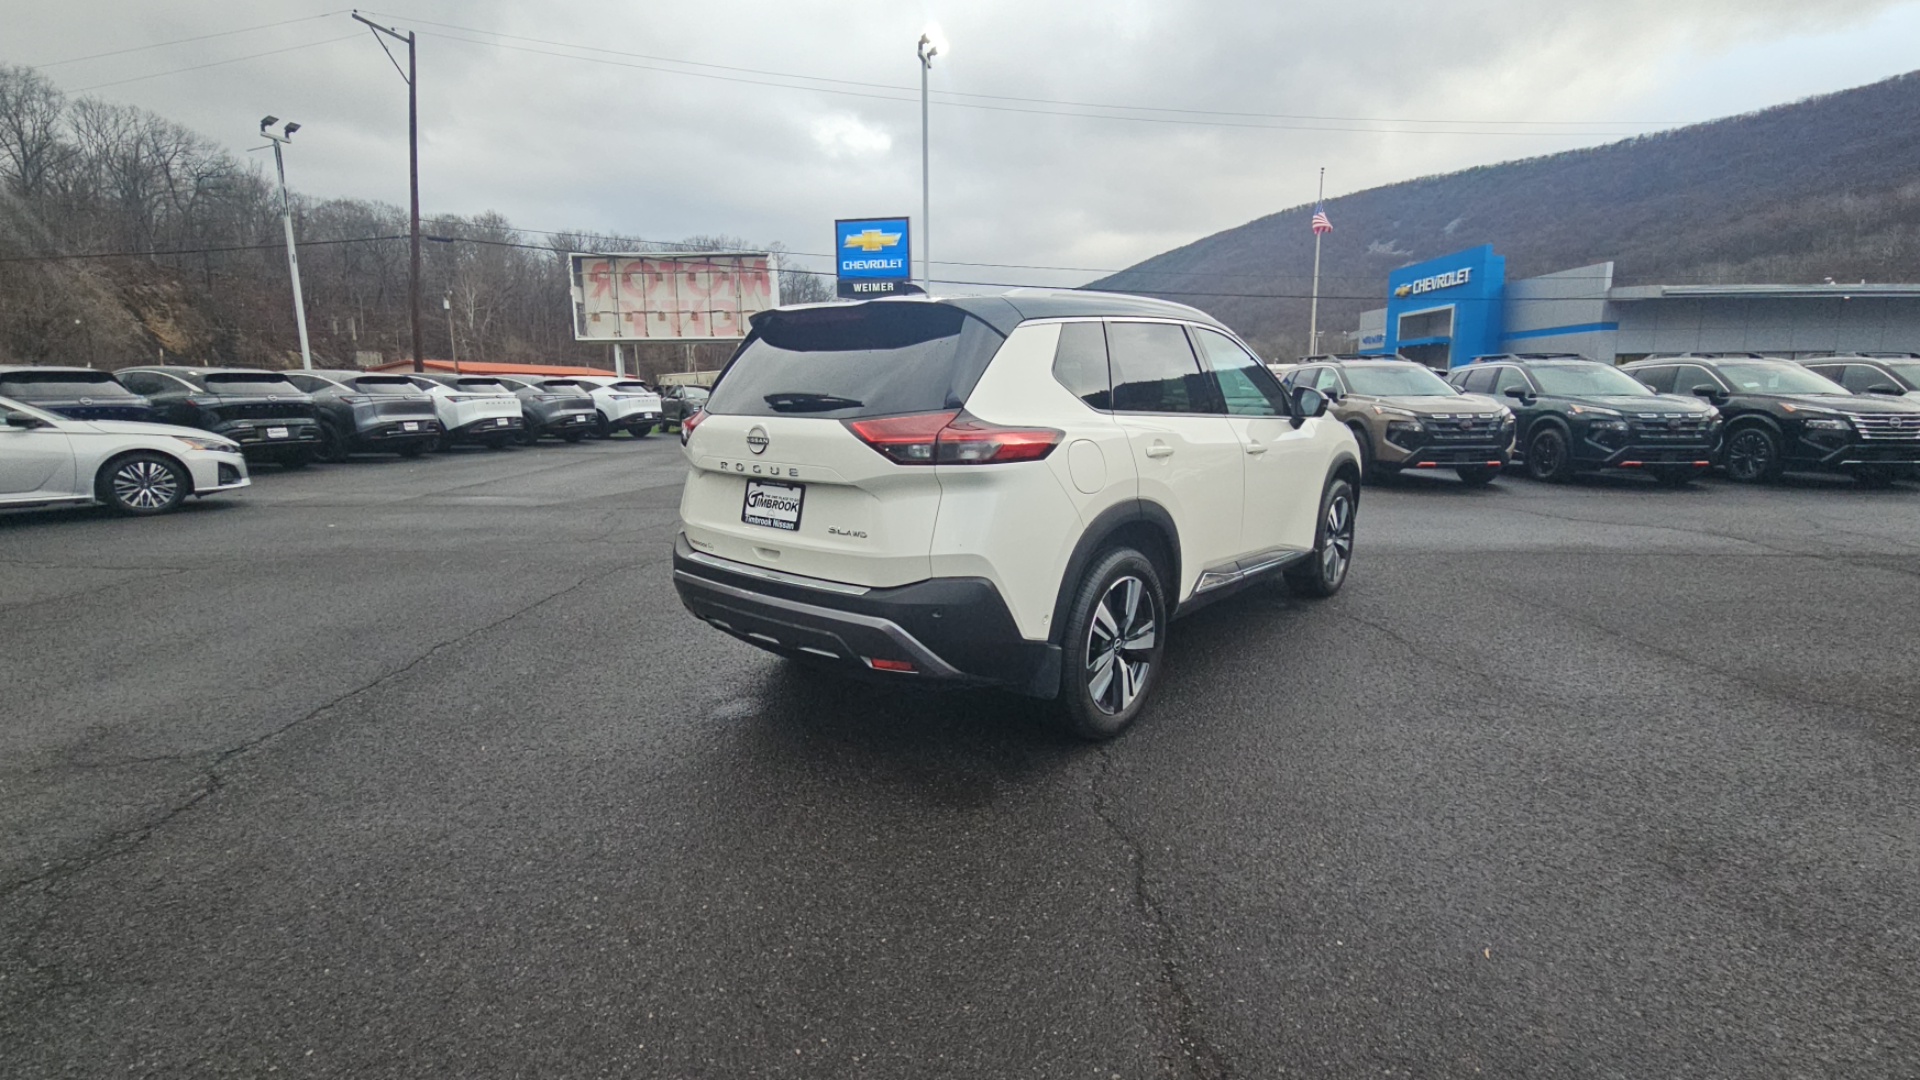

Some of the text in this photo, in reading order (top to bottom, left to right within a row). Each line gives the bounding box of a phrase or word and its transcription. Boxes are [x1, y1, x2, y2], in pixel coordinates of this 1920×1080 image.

[843, 259, 903, 270] CHEVROLET
[853, 283, 894, 292] WEIMER
[1413, 267, 1473, 294] CHEVROLET
[720, 461, 799, 477] ROGUE
[748, 491, 799, 512] TIMBROOK
[744, 514, 795, 530] Timbrook Nissan
